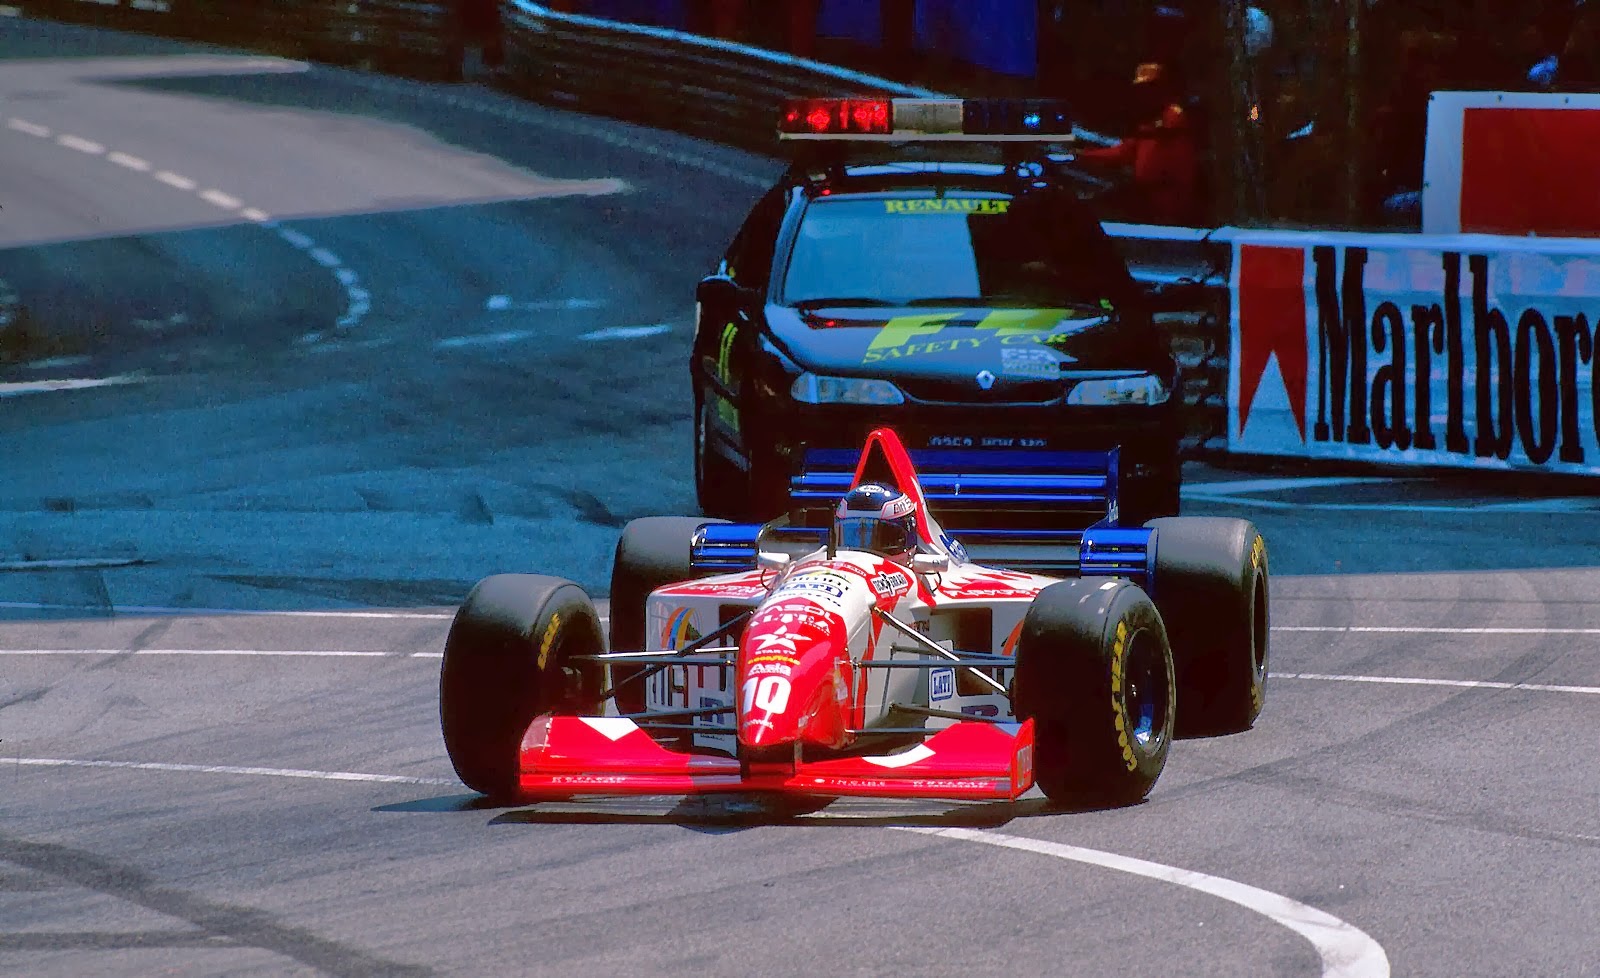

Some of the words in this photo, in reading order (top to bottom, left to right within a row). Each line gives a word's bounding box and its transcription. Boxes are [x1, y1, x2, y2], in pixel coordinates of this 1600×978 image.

[884, 199, 1010, 214] RENAULT
[862, 337, 987, 364] SAFETY
[1000, 333, 1068, 346] CAR
[1313, 246, 1600, 464] Marlbor
[742, 675, 792, 715] 10
